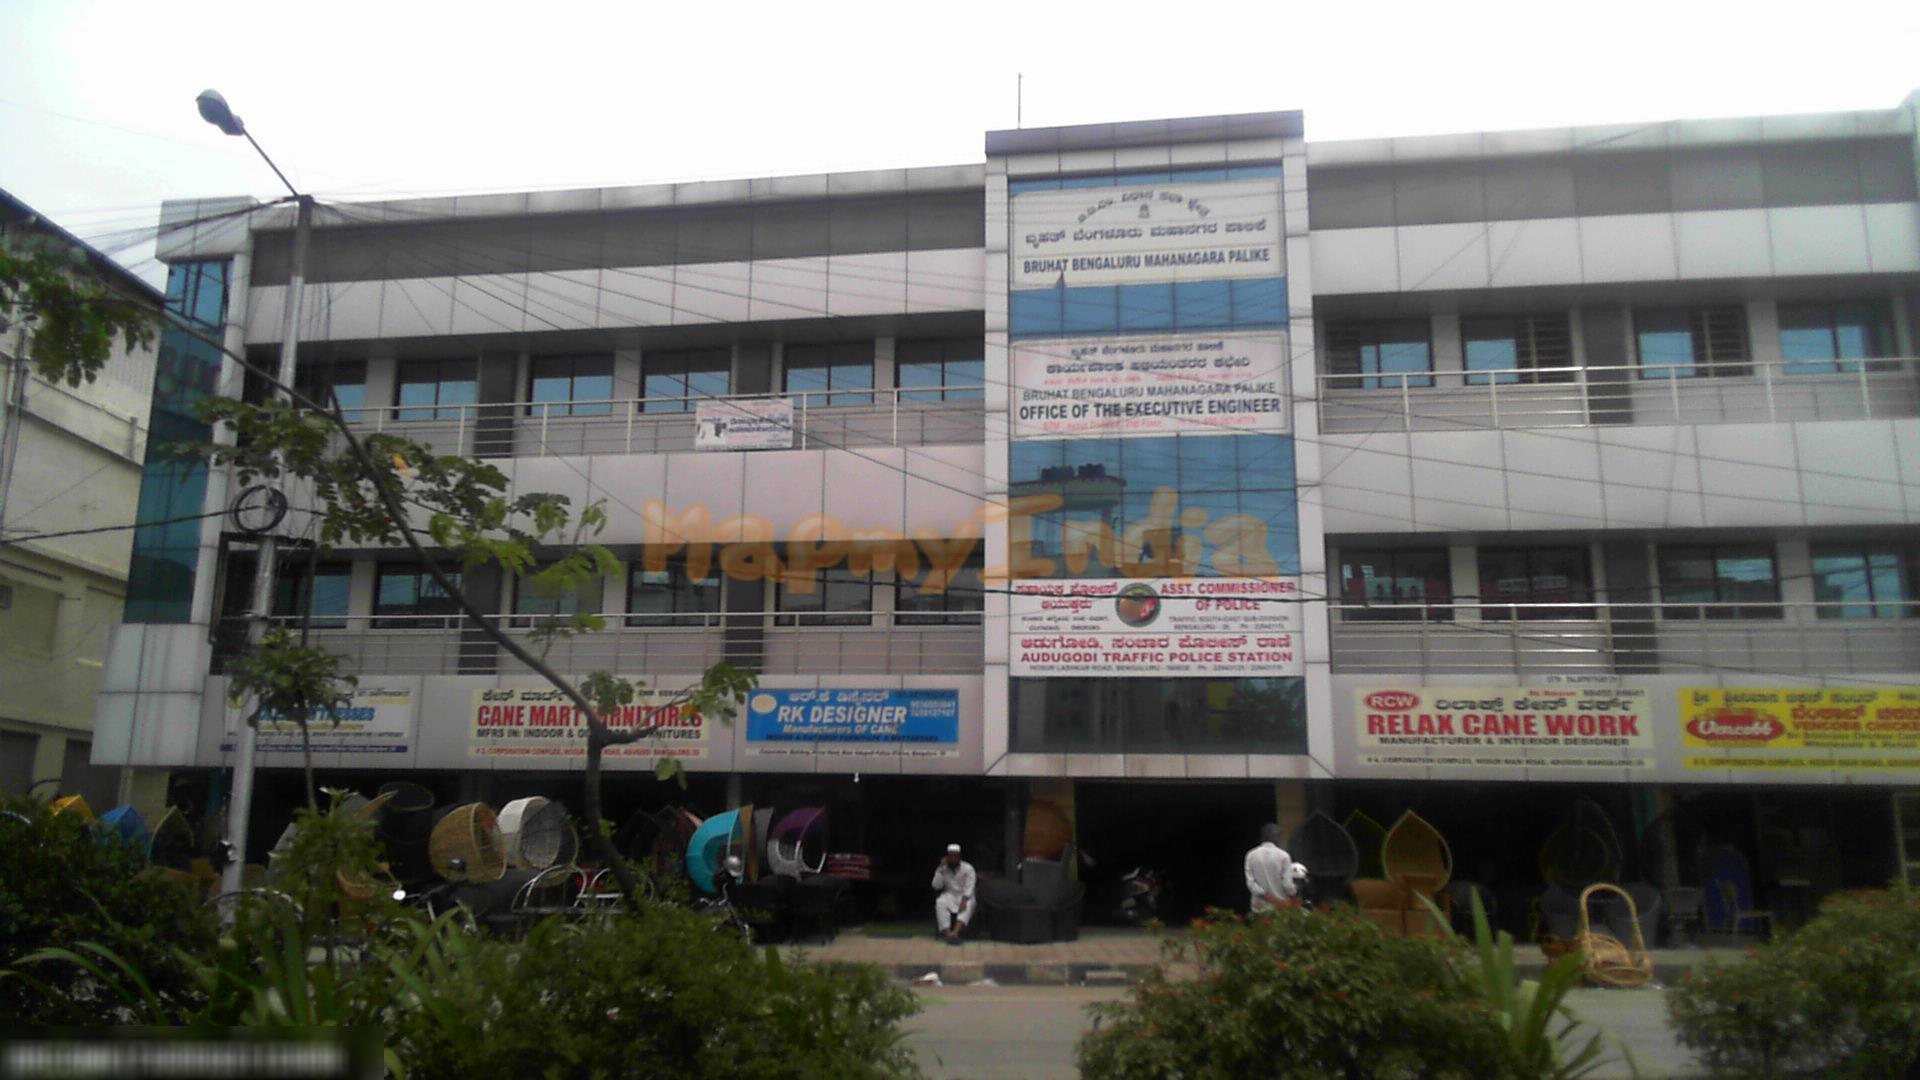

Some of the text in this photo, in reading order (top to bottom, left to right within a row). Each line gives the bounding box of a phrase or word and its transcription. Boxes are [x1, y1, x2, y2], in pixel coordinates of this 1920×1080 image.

[1023, 248, 1270, 274] BRUHAT BENGALURU MAHANAGARA PALIKE
[1023, 381, 1275, 402] BRUHAT BENGALURU MAHANAGARA PALIKE
[1019, 397, 1281, 420] OFFICE OF THE EXECUTIVE ENGINEER
[1160, 581, 1296, 595] ASST. COMMISSIONER
[1195, 599, 1262, 612] OF POLICE
[1021, 652, 1292, 663] AUDUGODI TRAFFIC POLICE STATION
[1370, 696, 1414, 708] RCW
[478, 705, 524, 727] CANE
[529, 704, 580, 727] MART
[777, 706, 804, 723] RK
[810, 705, 907, 723] DESIGNER
[783, 724, 851, 735] Manufacturers
[854, 724, 869, 735] OF
[1367, 714, 1640, 736] RELAX CANE WORK
[477, 729, 504, 738] MFRS
[523, 729, 563, 738] INDOOR
[567, 729, 574, 738] &
[1379, 736, 1630, 746] MANUFACTURER & INTERIOR DESIGNER
